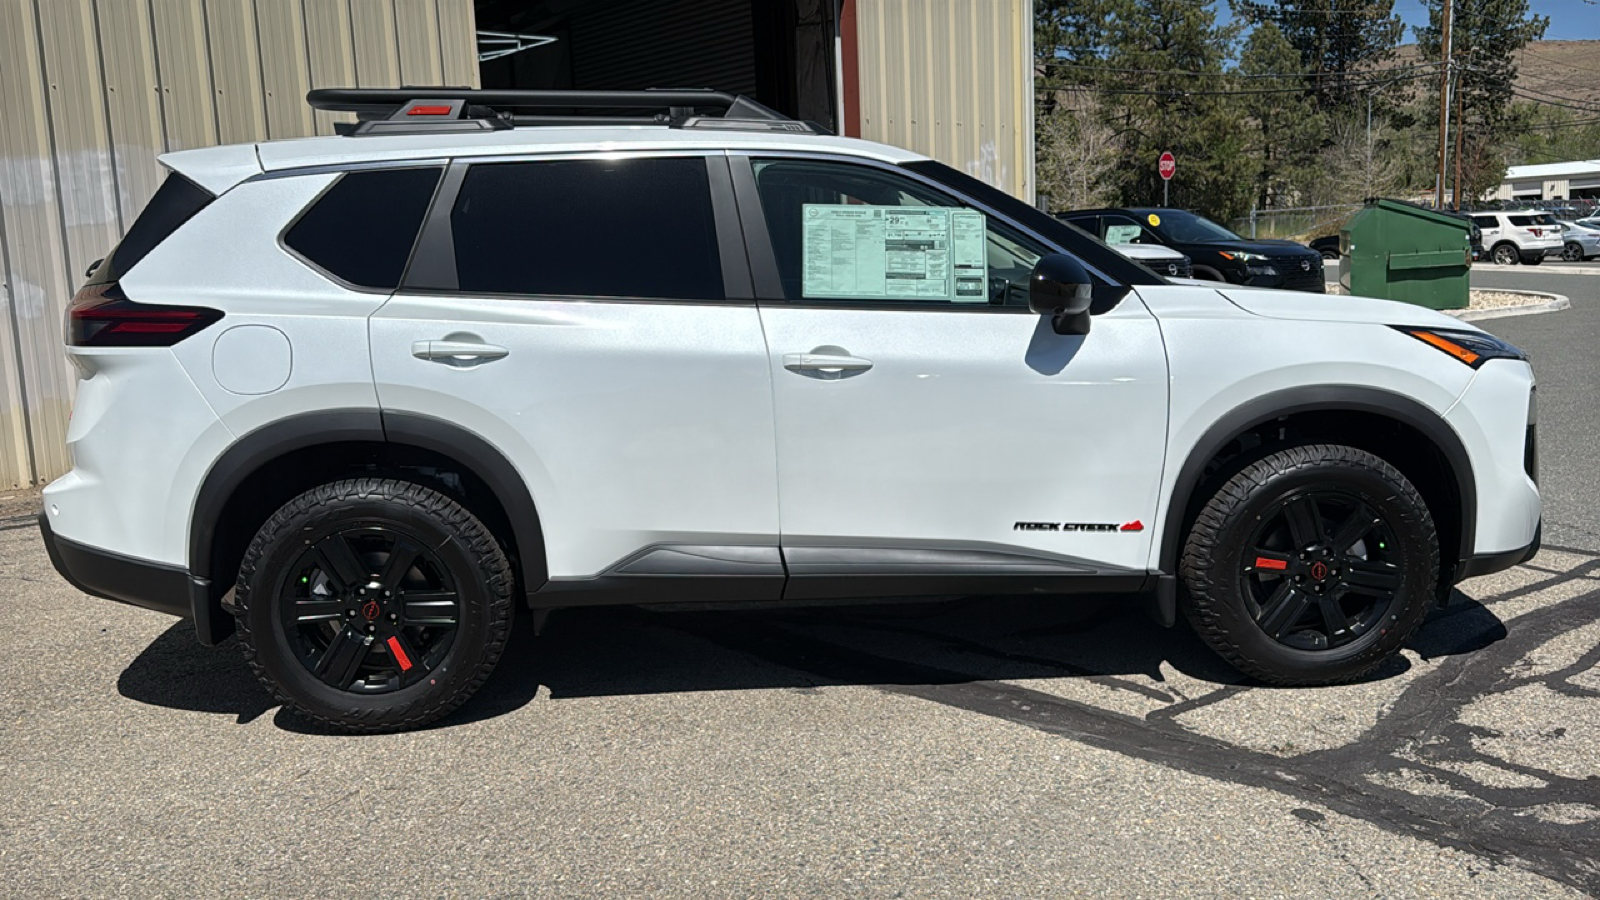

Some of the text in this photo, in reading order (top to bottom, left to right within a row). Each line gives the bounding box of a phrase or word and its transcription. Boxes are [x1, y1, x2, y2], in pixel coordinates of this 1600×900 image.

[1160, 160, 1174, 171] STOP
[1013, 521, 1120, 532] ROCK CREEK
